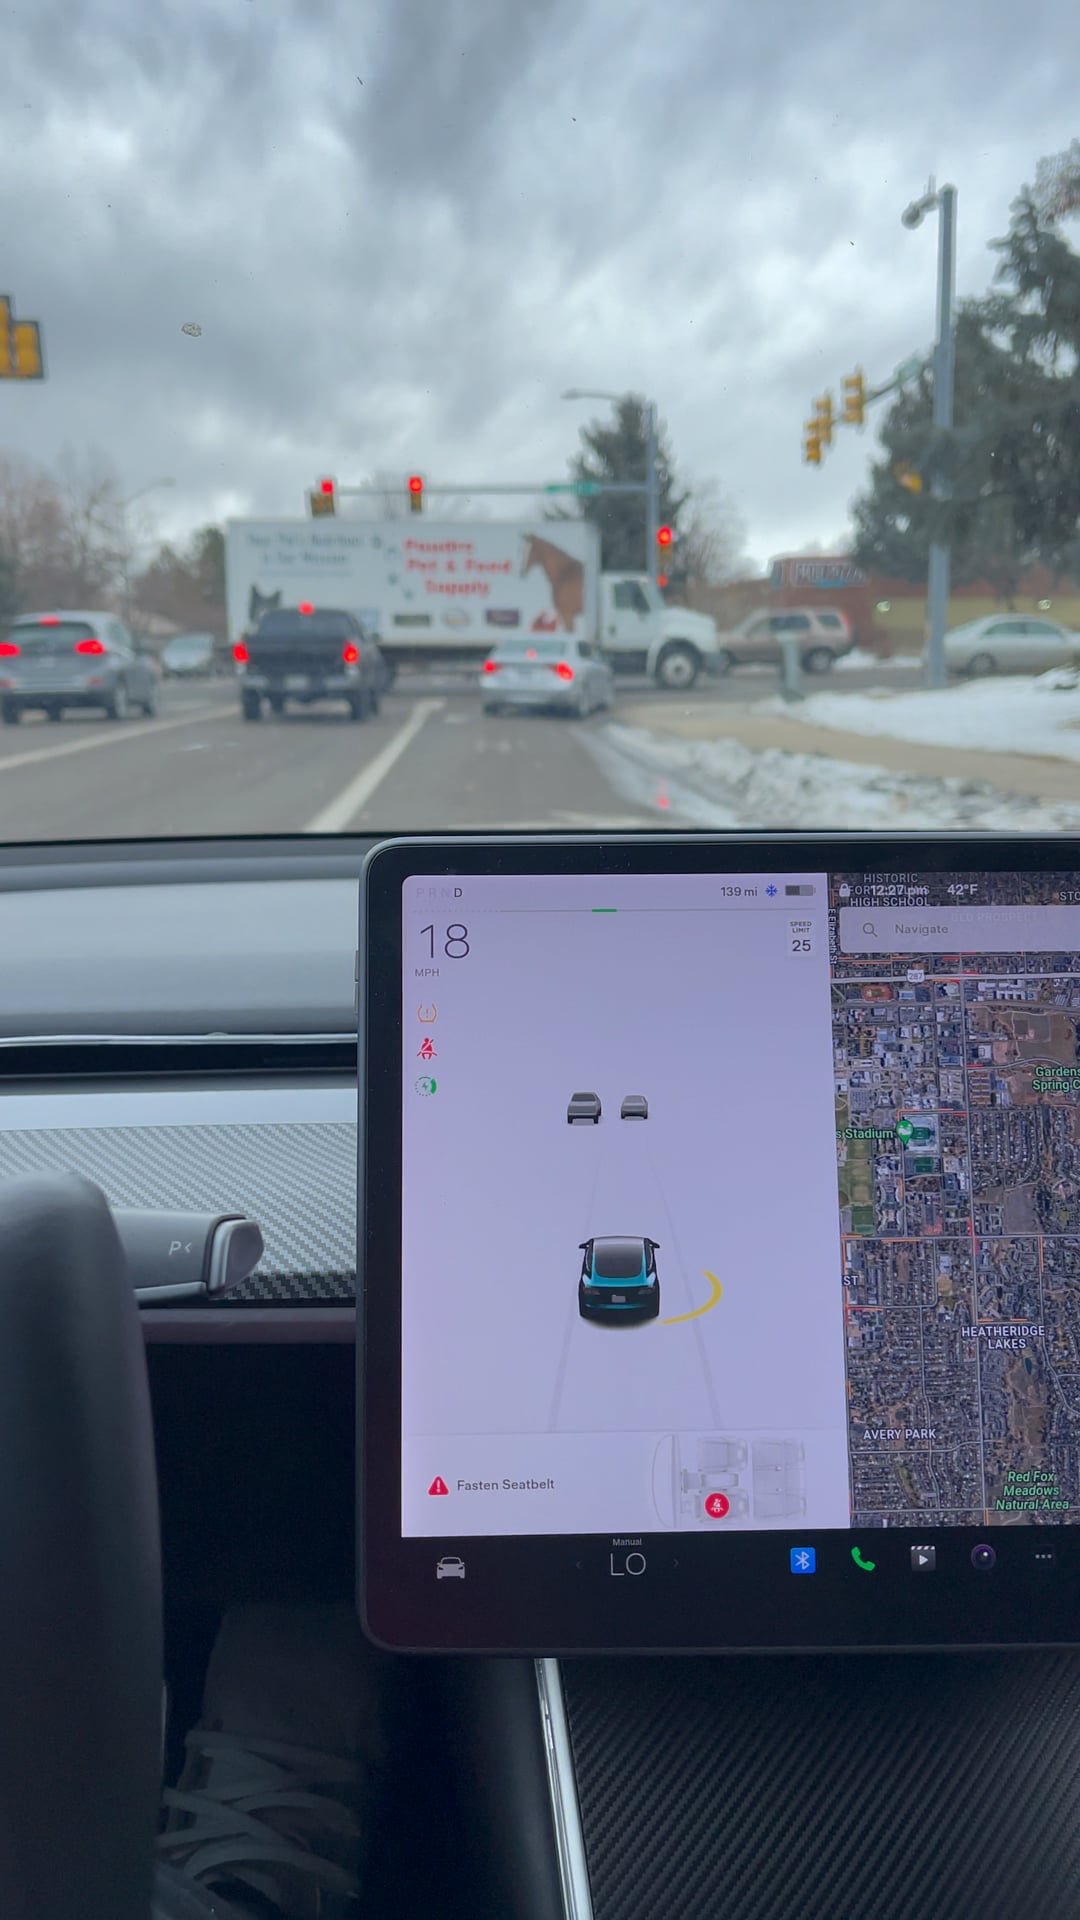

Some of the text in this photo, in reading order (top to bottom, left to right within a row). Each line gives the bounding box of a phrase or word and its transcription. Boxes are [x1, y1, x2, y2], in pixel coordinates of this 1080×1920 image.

[863, 873, 919, 883] HISTORIC
[454, 887, 463, 898] D
[720, 886, 758, 897] 139 mi
[870, 884, 905, 896] 12:27
[907, 886, 929, 899] pm
[946, 883, 979, 896] 42°F
[850, 896, 931, 907] HIGH SCHOOL
[895, 923, 949, 937] Navigate
[420, 923, 470, 959] 18
[791, 939, 812, 952] 25
[414, 968, 440, 977] MPH
[1035, 1066, 1080, 1077] Gardens
[1032, 1079, 1070, 1093] Spring
[845, 1128, 893, 1139] Stadium
[961, 1325, 1045, 1337] HEATHERIDGE
[988, 1339, 1026, 1349] LAKES
[863, 1428, 937, 1440] AVERY PARK
[1007, 1470, 1054, 1482] Red Fox
[457, 1478, 555, 1491] Fasten Seatbelt
[1003, 1485, 1060, 1496] Meadows
[996, 1499, 1070, 1511] Natural Area
[612, 1538, 642, 1546] Manual
[610, 1552, 647, 1576] LO
